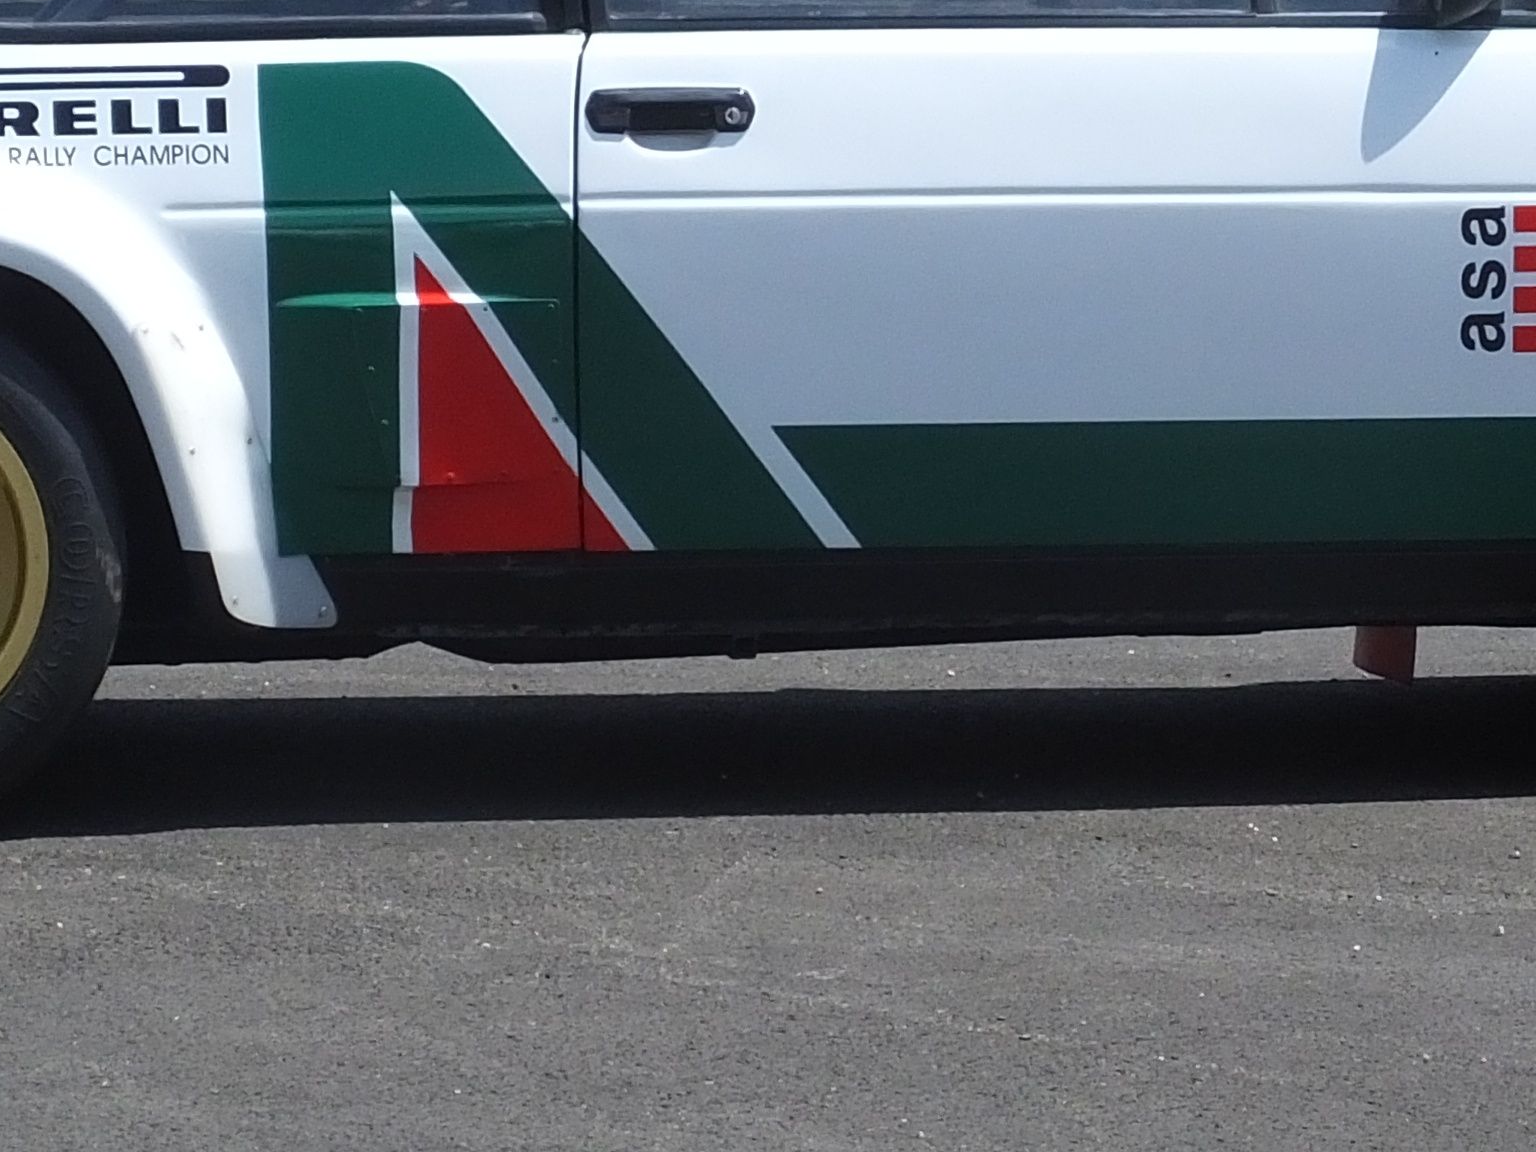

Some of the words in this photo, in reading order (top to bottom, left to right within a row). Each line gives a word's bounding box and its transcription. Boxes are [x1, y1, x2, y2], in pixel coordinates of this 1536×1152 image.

[8, 146, 76, 167] RALLY
[93, 144, 230, 167] CHAMPION
[1461, 205, 1507, 353] asa
